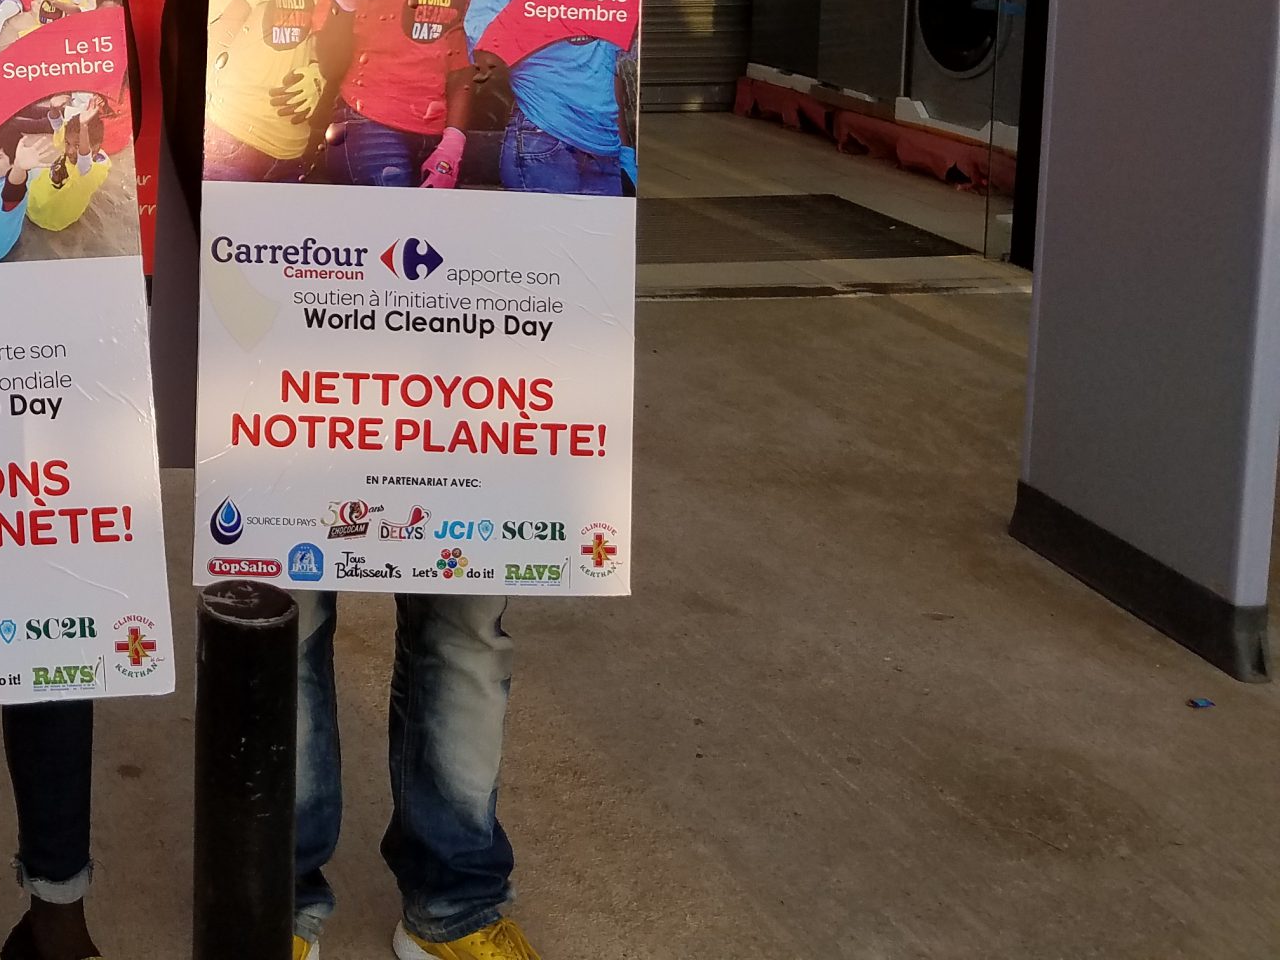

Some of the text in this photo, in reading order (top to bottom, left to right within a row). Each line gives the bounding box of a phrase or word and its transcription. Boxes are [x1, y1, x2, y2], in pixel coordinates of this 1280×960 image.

[524, 2, 627, 22] Septembre
[65, 36, 113, 54] Le 15
[3, 58, 114, 81] Septembre
[211, 236, 368, 268] Carrefour
[284, 266, 364, 281] Cameroun
[446, 266, 560, 287] apporte son
[293, 289, 563, 314] soutien à l'initiative mondiale
[304, 307, 553, 341] World CleanUp Day
[30, 343, 67, 359] son
[281, 369, 554, 412] NETTOYONS
[10, 393, 63, 419] Day
[231, 411, 607, 457] NOTRE PLANÈTE!
[366, 475, 482, 489] EN PARTENARIAT AVEC:
[247, 516, 316, 526] SOURCE DU PAYS
[331, 525, 365, 537] CHOCOCAM
[381, 526, 423, 539] DELYS
[434, 519, 473, 540] JCI
[502, 520, 566, 541] SC2R
[581, 523, 617, 536] CLINIQUE
[212, 560, 277, 573] TopSaho
[342, 551, 365, 566] Tous
[413, 568, 495, 579] Let's do it!
[505, 564, 560, 580] RAVS
[580, 564, 616, 578] KERTHAN
[25, 616, 97, 640] SC2R
[113, 615, 155, 630] CLINIQUE
[32, 665, 95, 685] RAVS
[115, 662, 158, 678] KERTHAN
[11, 673, 21, 685] it!
